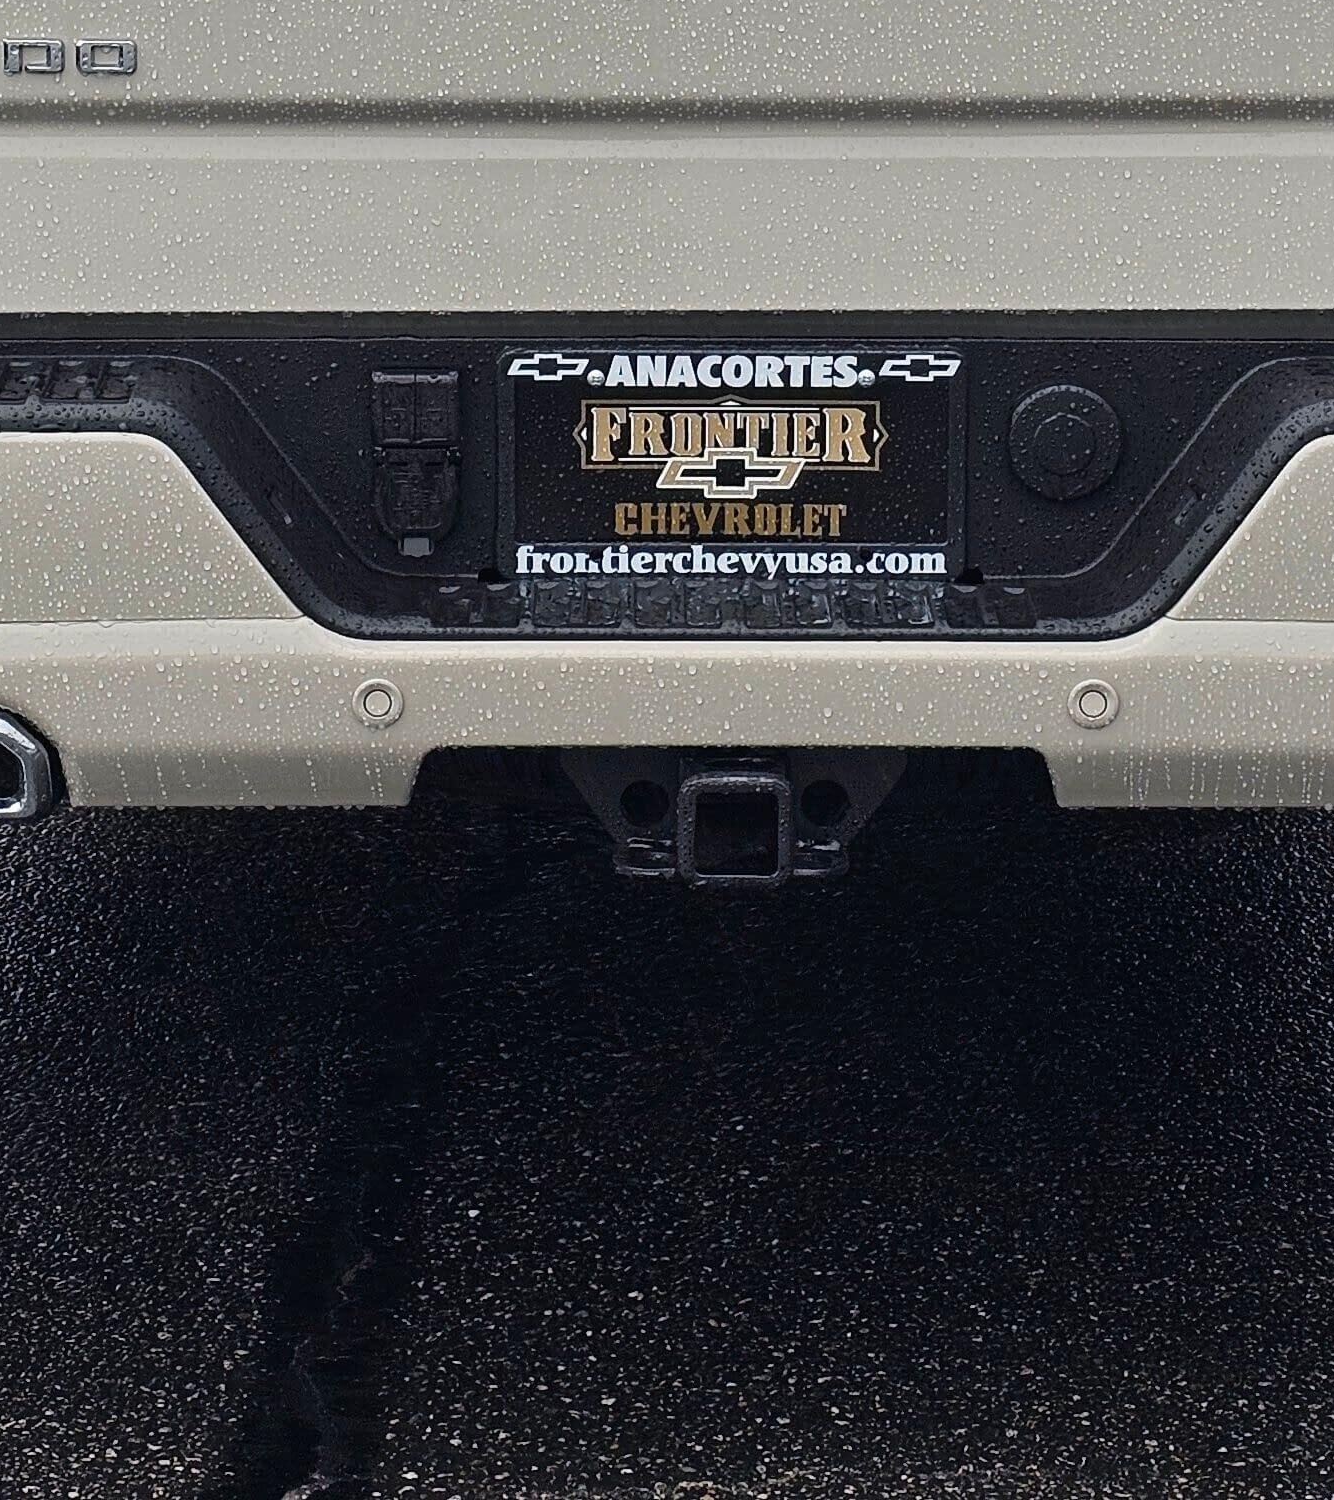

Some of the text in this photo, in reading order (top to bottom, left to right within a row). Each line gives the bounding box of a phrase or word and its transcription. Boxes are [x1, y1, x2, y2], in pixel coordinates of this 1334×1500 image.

[606, 355, 859, 387] ANACORTES
[590, 407, 871, 463] FRONTIER
[614, 502, 848, 537] CHEVROLET
[515, 545, 948, 580] frontierchevyusa.com
